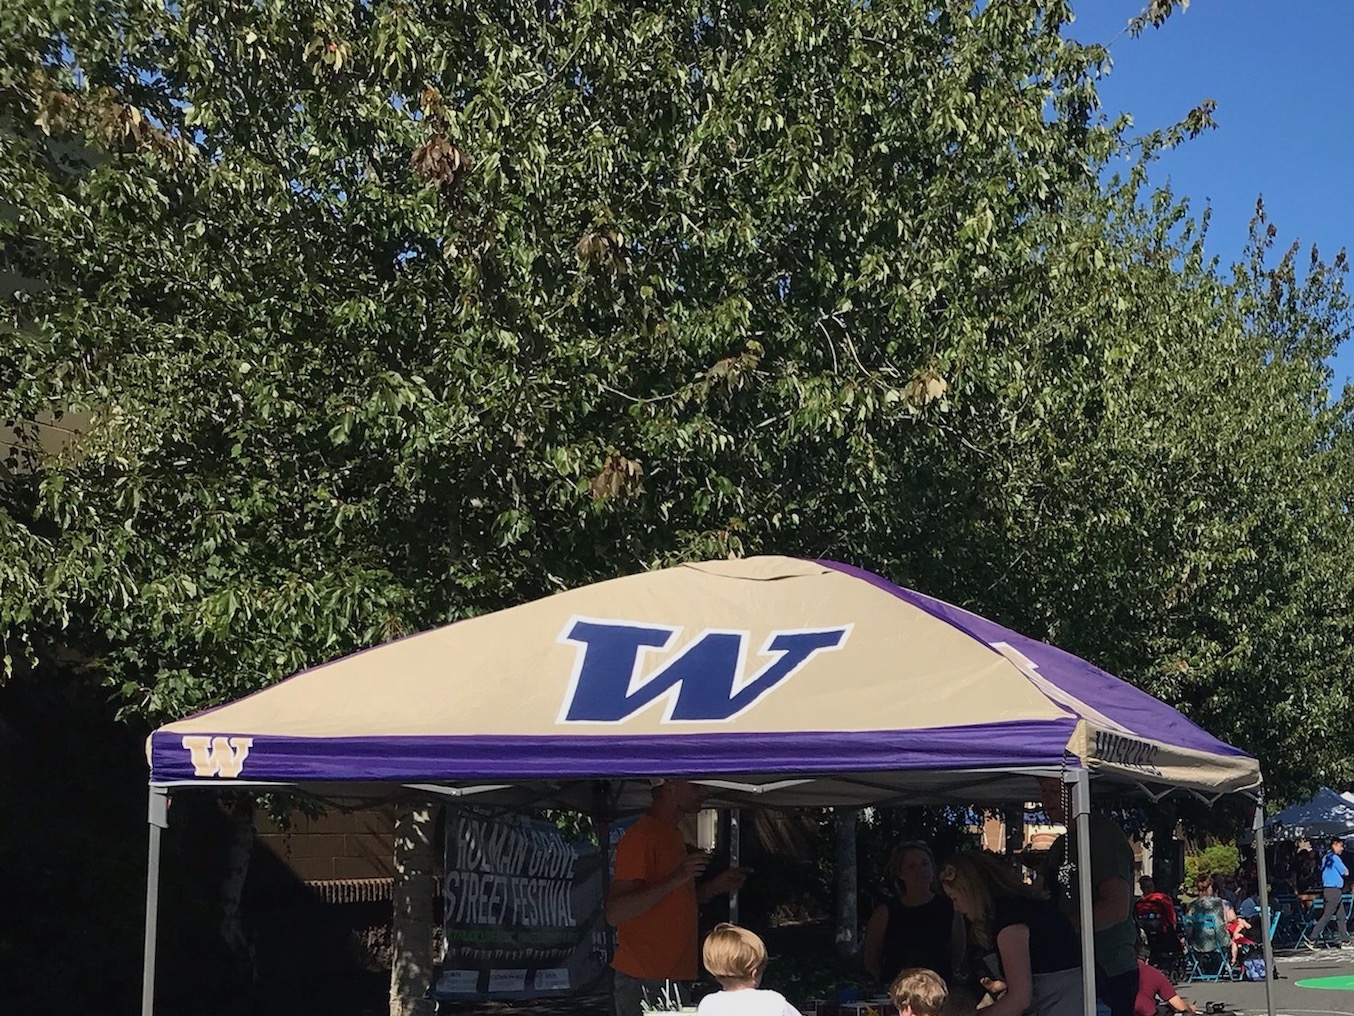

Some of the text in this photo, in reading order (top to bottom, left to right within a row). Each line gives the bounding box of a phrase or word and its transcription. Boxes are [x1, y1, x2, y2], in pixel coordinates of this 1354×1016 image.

[556, 615, 855, 725] W
[182, 735, 254, 778] W
[457, 818, 528, 876] HOLMAN
[528, 829, 580, 879] GROVE
[445, 870, 577, 927] STREET FESTIVAL
